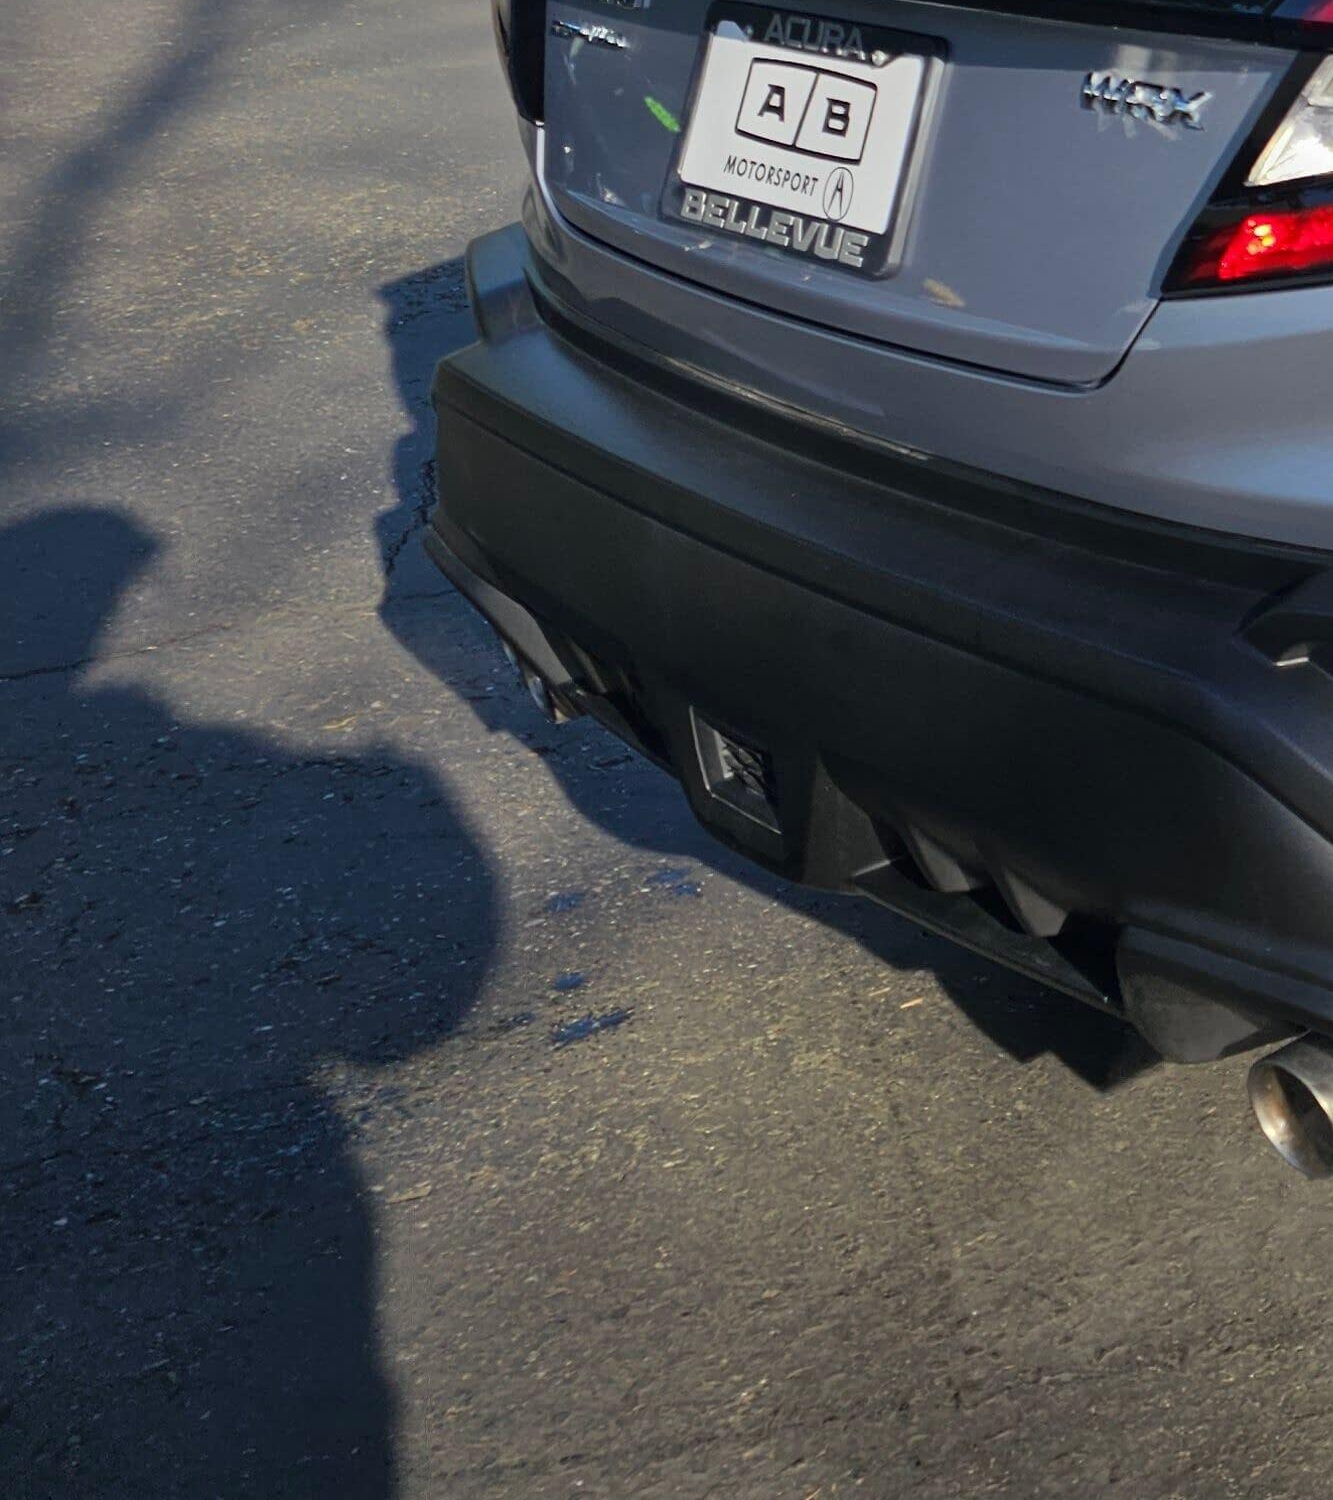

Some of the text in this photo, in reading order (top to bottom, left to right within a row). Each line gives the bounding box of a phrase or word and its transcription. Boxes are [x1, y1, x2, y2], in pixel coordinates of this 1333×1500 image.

[764, 13, 866, 62] ACURA
[723, 155, 819, 197] MOTORSPORT
[680, 190, 870, 269] BELLEVUE
